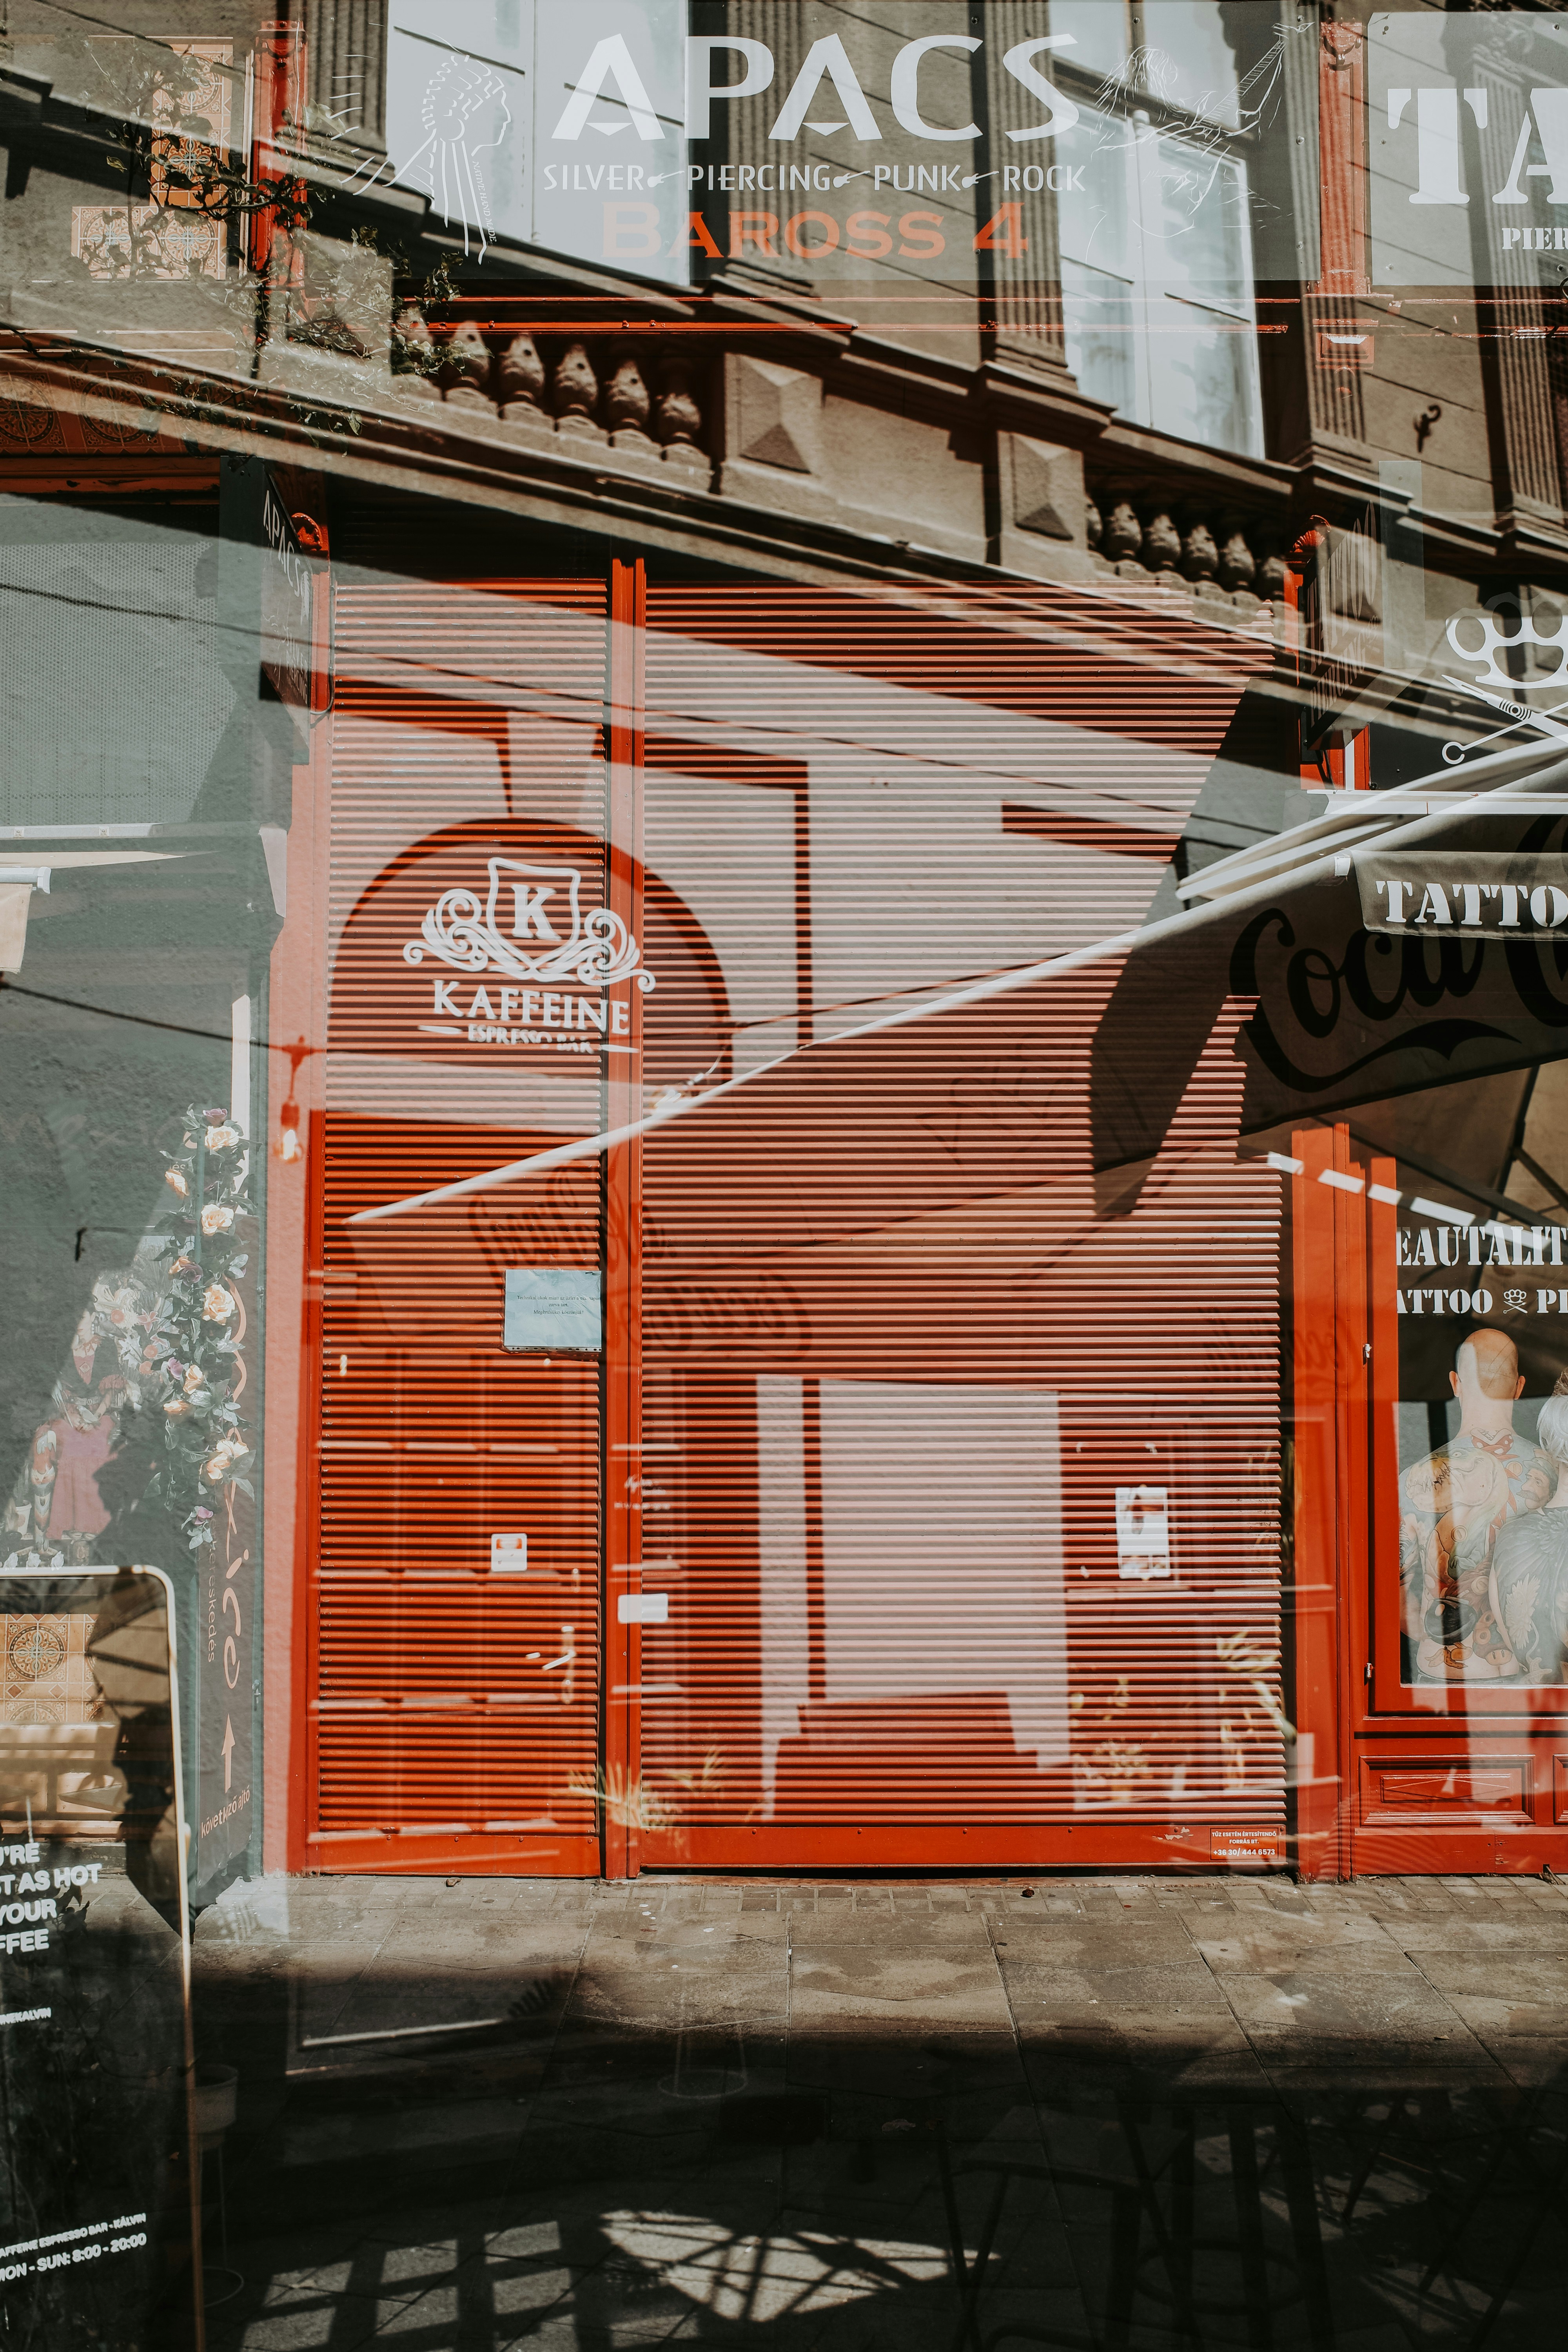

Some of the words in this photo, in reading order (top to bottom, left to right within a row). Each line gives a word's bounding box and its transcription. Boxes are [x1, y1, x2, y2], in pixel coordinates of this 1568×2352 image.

[551, 33, 1079, 142] APACS
[1388, 89, 1568, 204] TA
[472, 161, 485, 191] NATIVE
[479, 192, 491, 216] HAND
[485, 218, 497, 242] MADE
[544, 164, 644, 191] SILVER
[687, 164, 830, 191] PIERCING
[874, 164, 963, 191] PUNK
[1004, 164, 1086, 191] ROCK
[601, 201, 945, 259] BAROSS
[973, 202, 1029, 258] 4
[263, 490, 301, 597] APACS
[286, 650, 308, 705] PIERCING
[511, 884, 562, 941] K
[1376, 880, 1568, 927] TATTO
[433, 980, 630, 1035] KAFFEINE
[468, 1023, 553, 1049] ESPRESSO
[238, 1784, 250, 1811] ajtó
[18, 1869, 51, 1894] AS
[54, 1863, 102, 1889] HOT
[1228, 1847, 1241, 1857] 30/
[37, 2252, 71, 2272] SUN:
[72, 2244, 102, 2263] 8:00
[110, 2232, 147, 2253] 20:00
